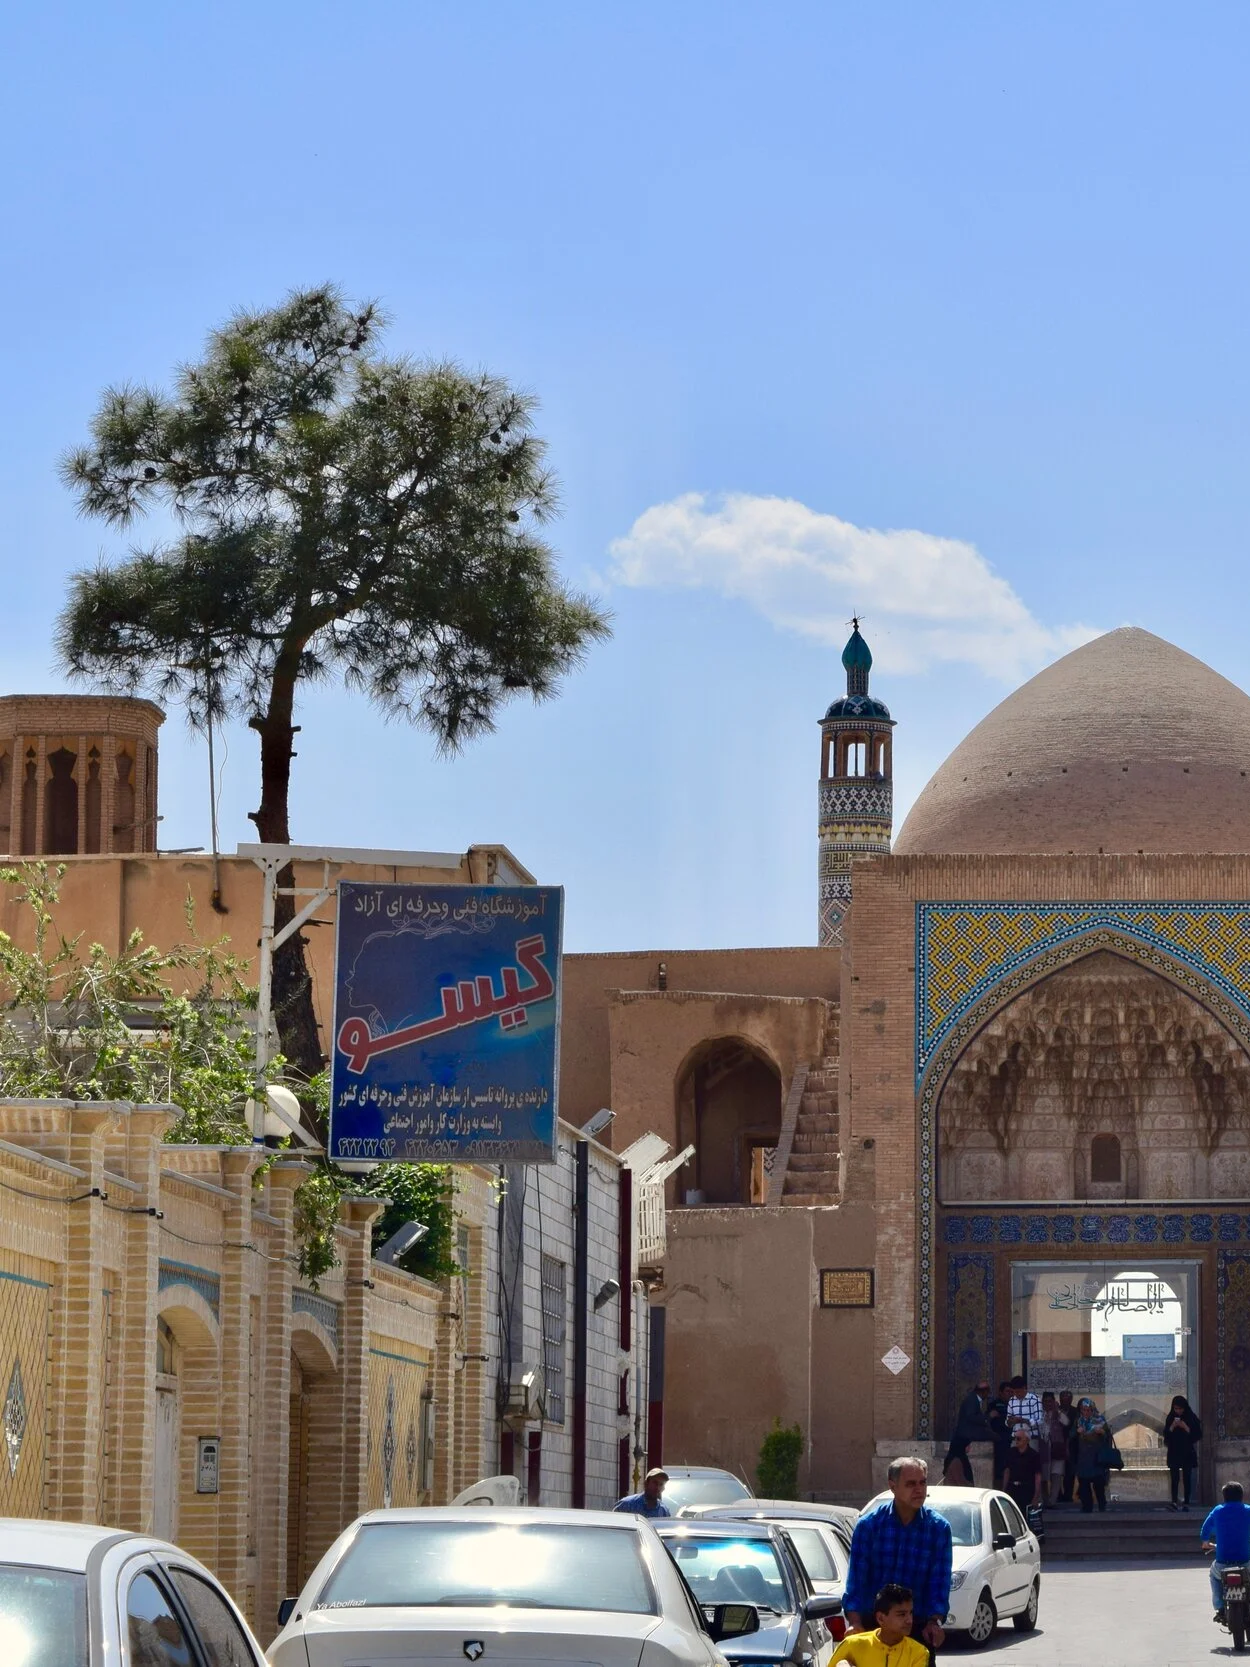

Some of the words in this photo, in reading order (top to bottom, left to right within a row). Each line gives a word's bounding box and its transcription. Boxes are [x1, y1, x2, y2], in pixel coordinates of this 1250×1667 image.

[354, 891, 384, 916] آزاد
[386, 895, 402, 917] ای
[453, 896, 478, 920] فنی
[482, 894, 548, 922] آموزشگاه
[337, 933, 554, 1075] گیسو
[338, 1084, 358, 1107] کشور
[358, 1085, 369, 1106] ای
[393, 1083, 407, 1107] فنی
[408, 1083, 435, 1108] آموزش
[435, 1086, 461, 1108] سازمان
[462, 1086, 470, 1108] از
[383, 1112, 414, 1135] اجتماعی
[435, 1112, 447, 1134] کار
[449, 1113, 471, 1135] وزارت
[472, 1118, 479, 1134] به
[480, 1113, 502, 1135] وابسته
